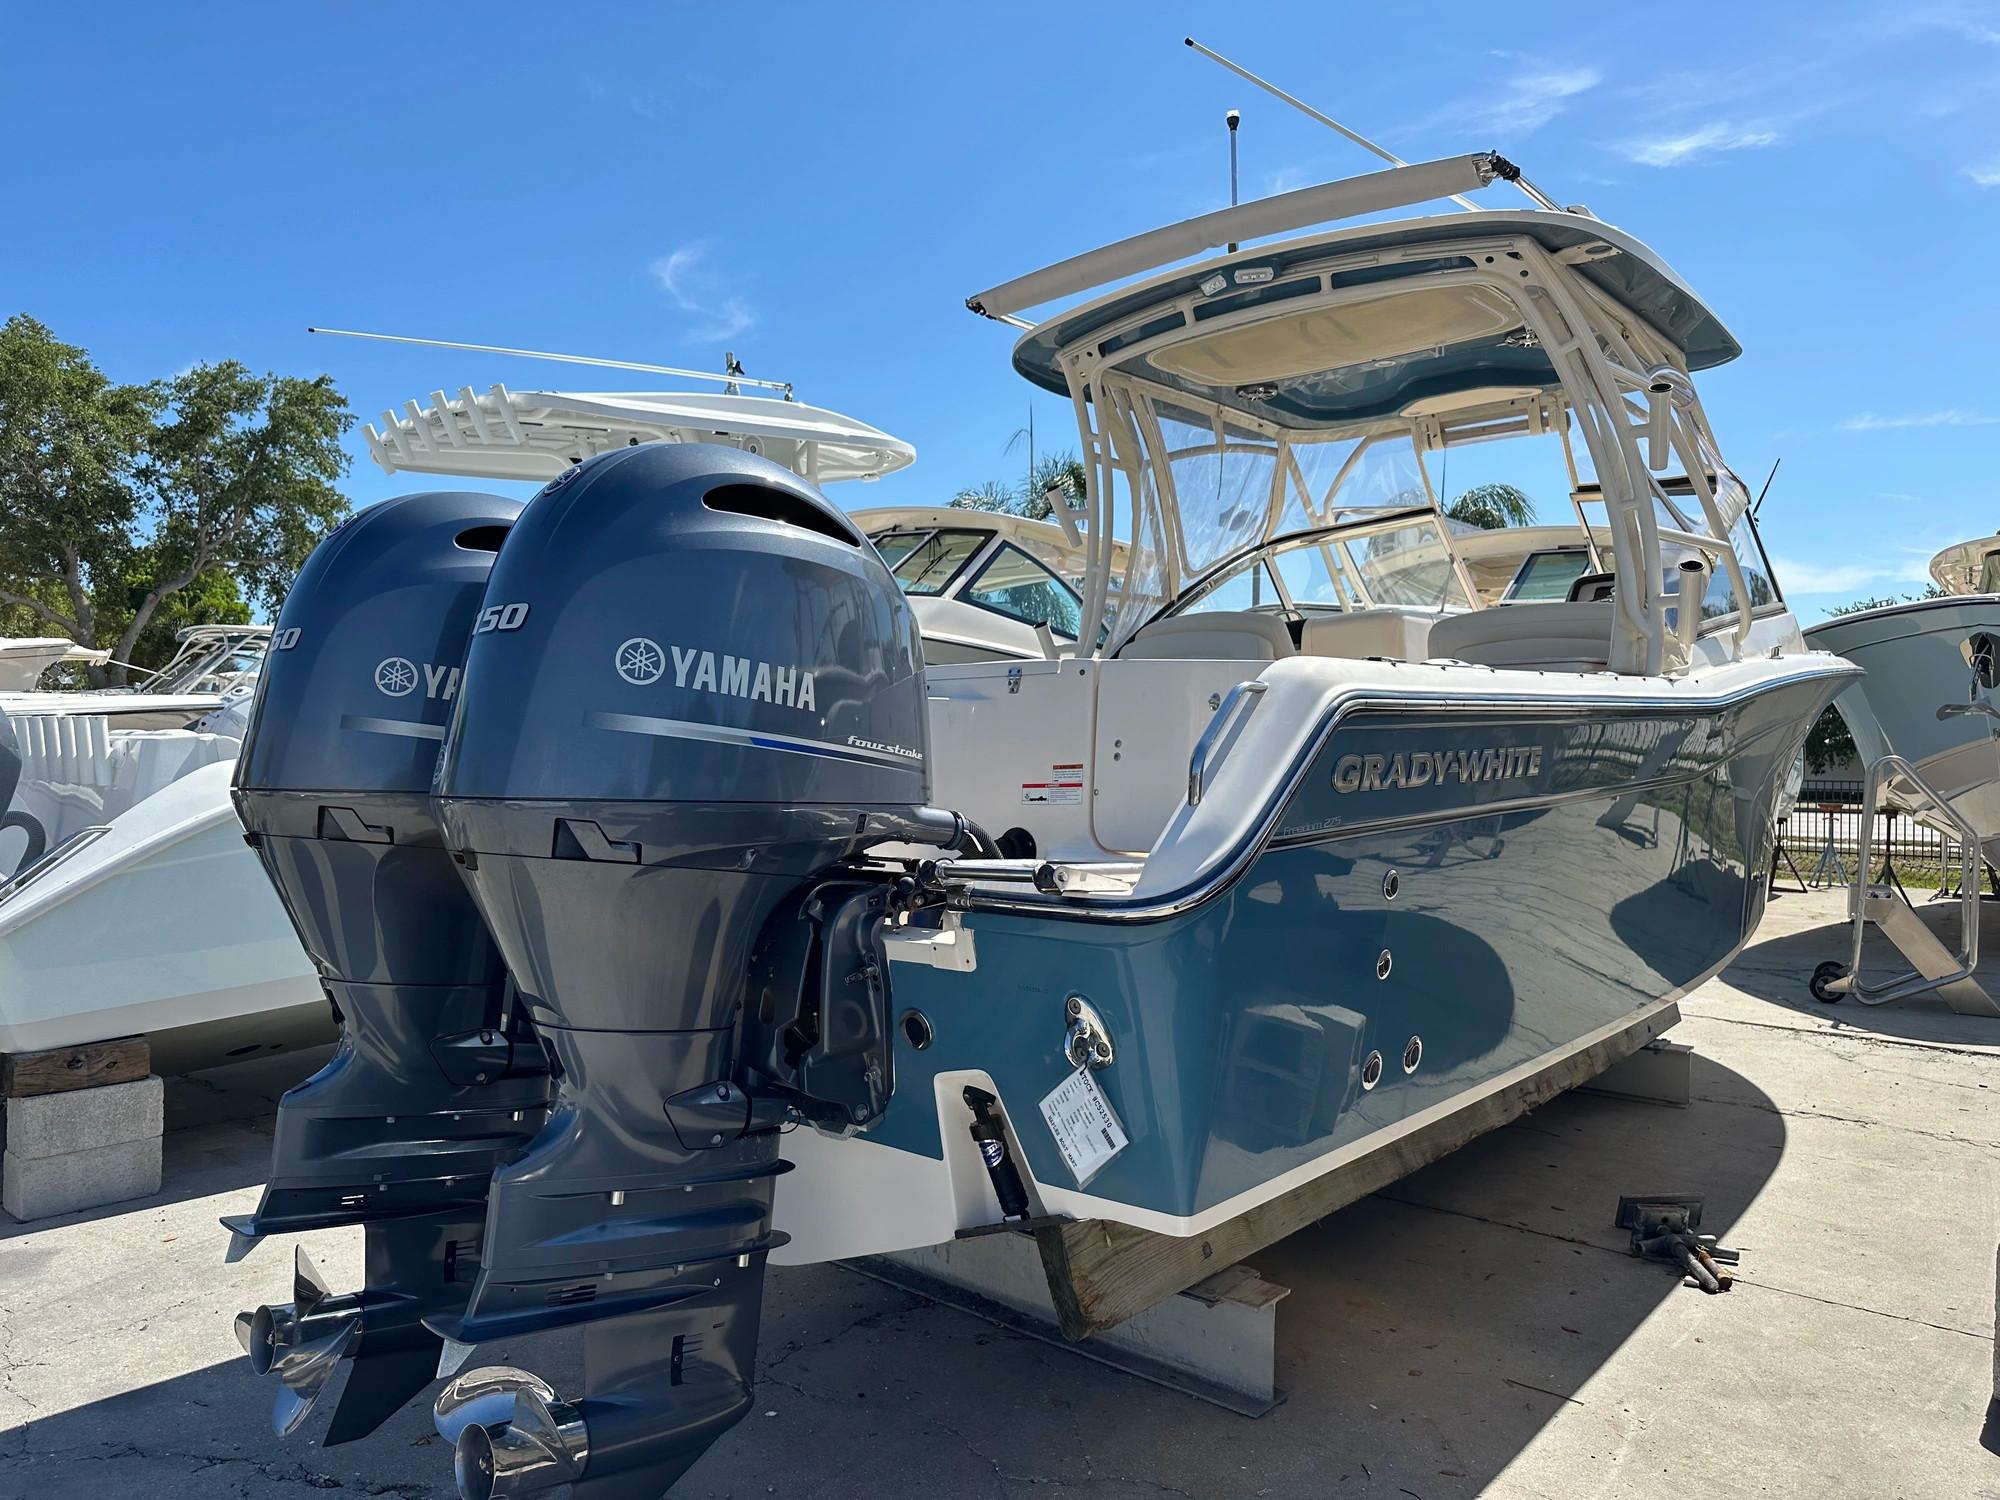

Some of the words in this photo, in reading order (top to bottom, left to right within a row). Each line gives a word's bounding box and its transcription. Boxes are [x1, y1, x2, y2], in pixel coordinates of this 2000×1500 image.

[671, 645, 816, 712] YAMAHA
[1332, 745, 1543, 793] GRADY-WHITE
[1079, 1071, 1094, 1093] TOCK
